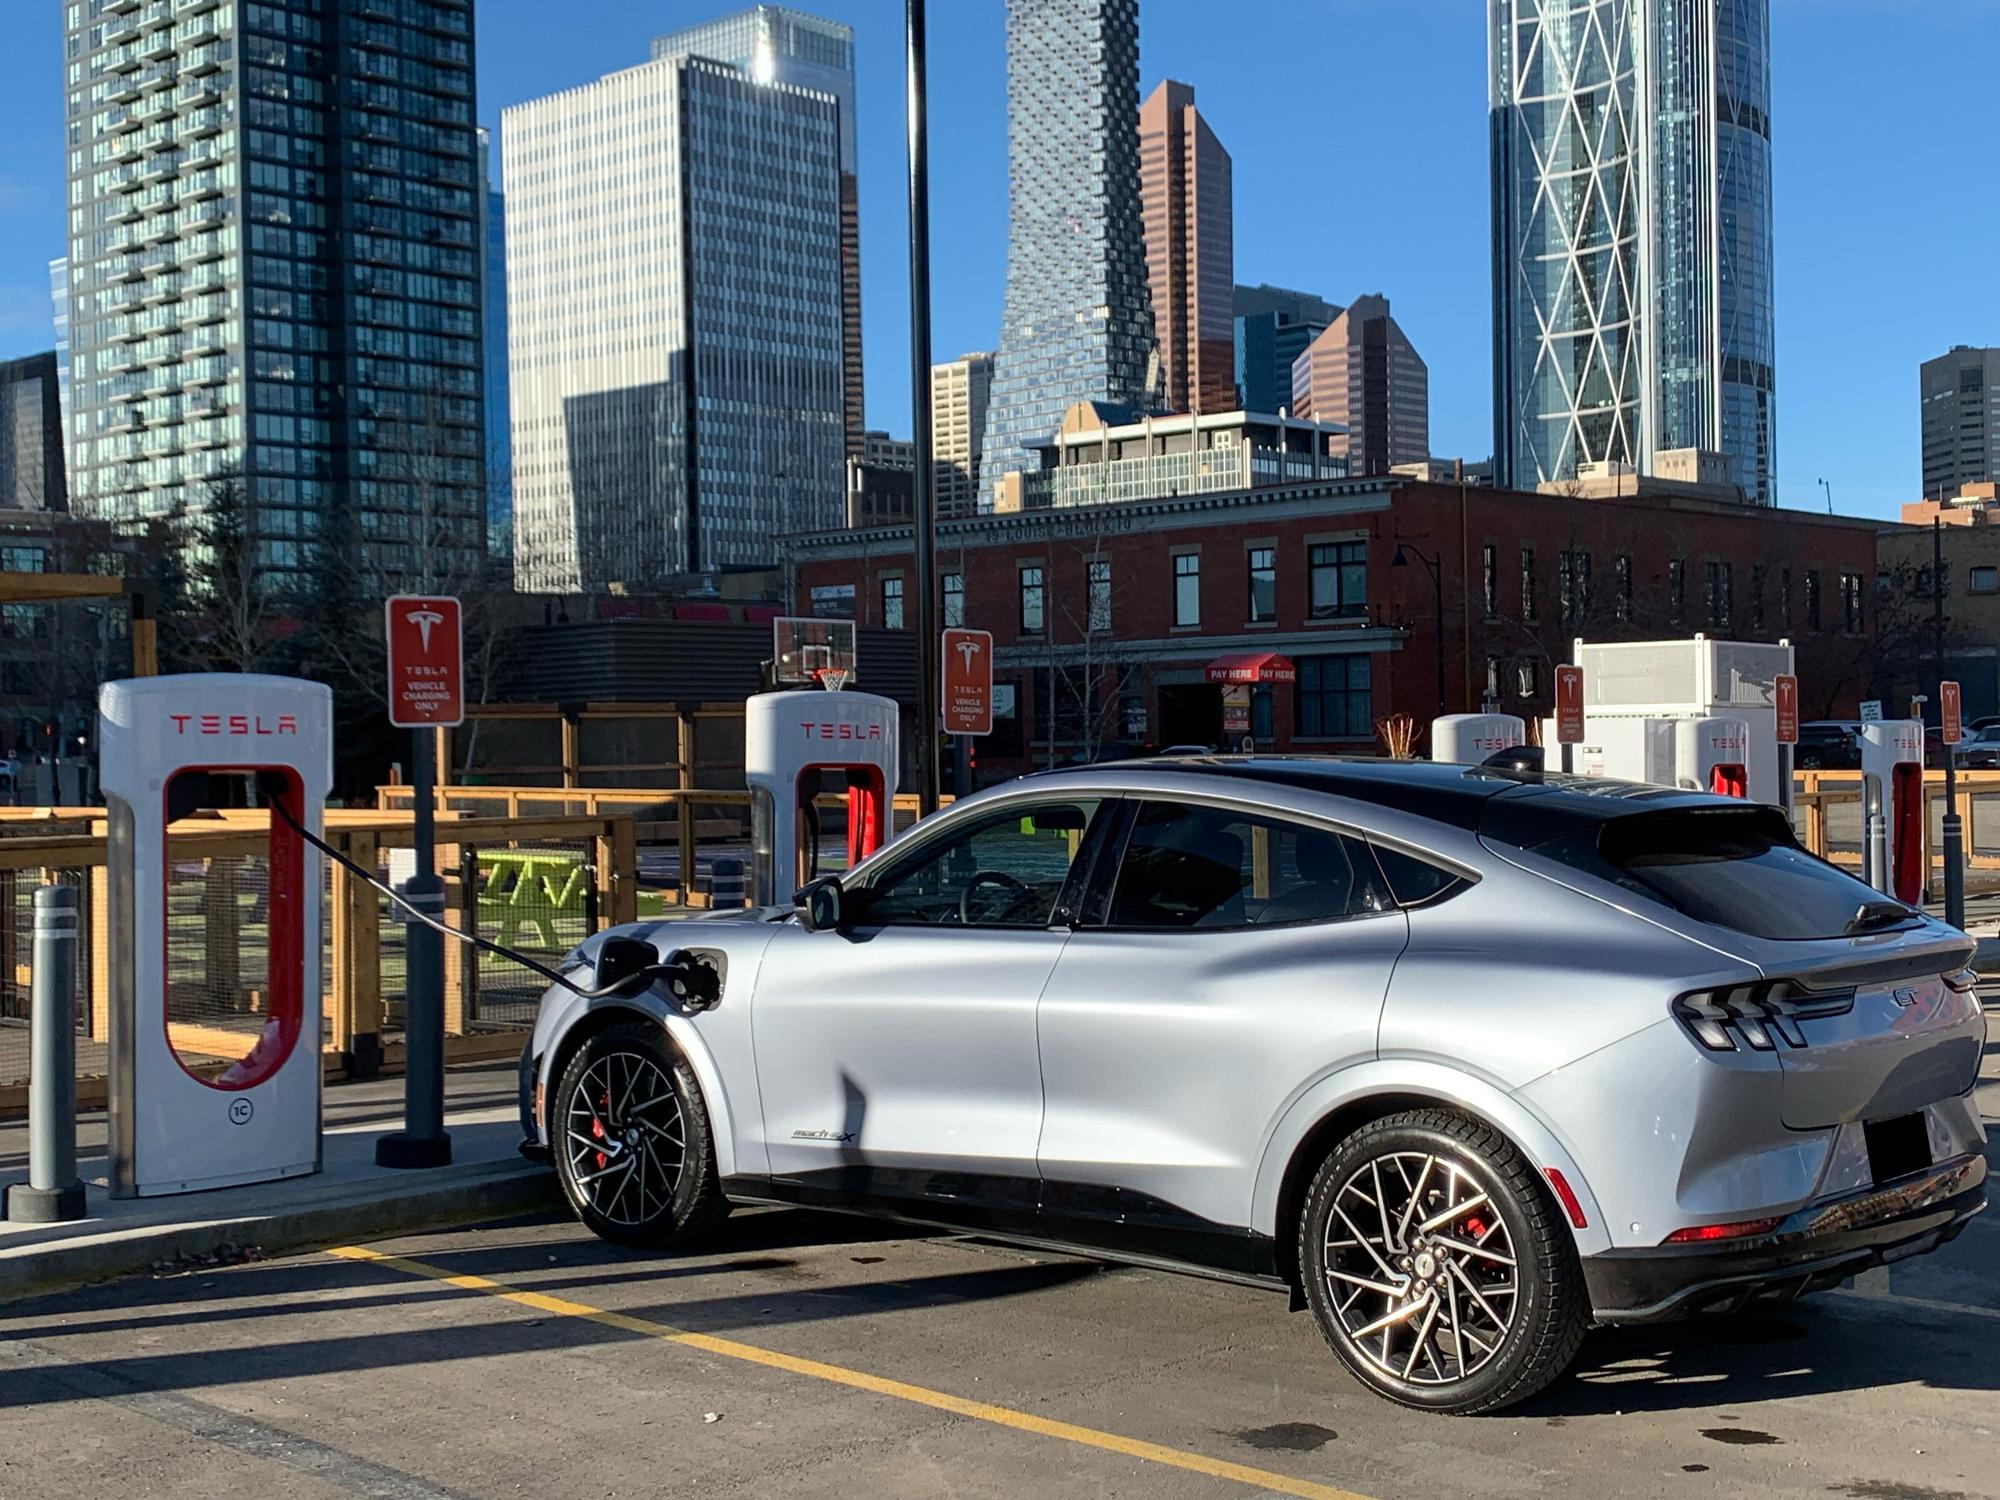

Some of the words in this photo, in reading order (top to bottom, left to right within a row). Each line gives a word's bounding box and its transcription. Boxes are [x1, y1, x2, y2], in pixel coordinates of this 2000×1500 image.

[405, 666, 448, 675] TESLA
[1211, 669, 1227, 679] PAY
[1229, 669, 1253, 678] HERE
[1260, 669, 1274, 678] PAY
[1275, 670, 1295, 679] HERE
[954, 686, 983, 694] TESLA
[169, 715, 297, 735] TESLA
[800, 723, 881, 739] TESLA
[234, 1105, 248, 1117] 1C
